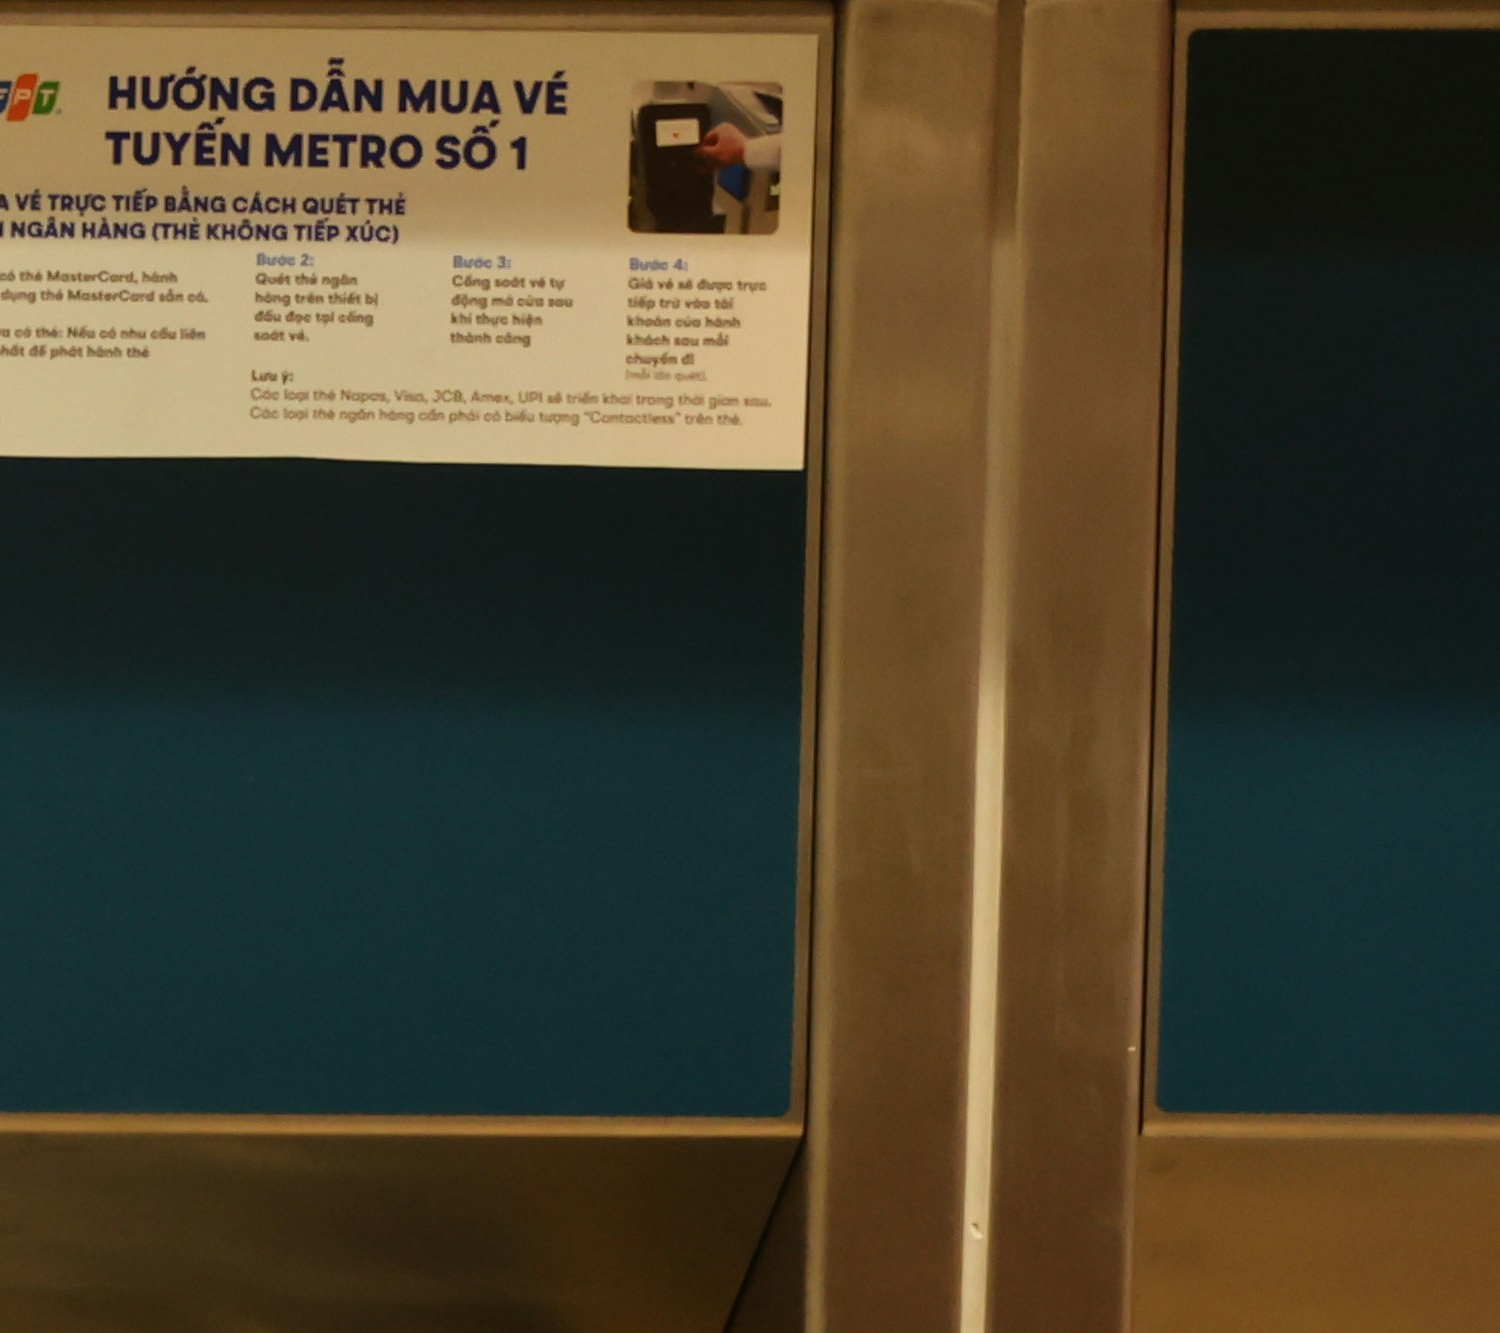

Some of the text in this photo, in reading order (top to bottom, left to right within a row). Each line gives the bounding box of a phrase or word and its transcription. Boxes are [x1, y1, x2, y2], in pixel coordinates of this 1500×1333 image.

[108, 57, 568, 115] HƯỚNG DẪN MUA VÉ
[105, 117, 527, 170] TUYẾN METRO SỐ 1
[15, 189, 42, 211] VÉ
[47, 193, 106, 216] TRỰC
[111, 188, 158, 212] TIẾP
[164, 186, 226, 213] BẰNG
[232, 191, 296, 214] CÁCH
[302, 192, 360, 215] QUÉT
[365, 192, 406, 215] THẺ
[10, 217, 75, 238] NGÂN
[82, 217, 146, 239] HÀNG
[152, 217, 200, 241] (THẺ
[206, 218, 288, 241] KHÔNG
[293, 217, 340, 241] TIẾP
[346, 219, 399, 244] XÚC)
